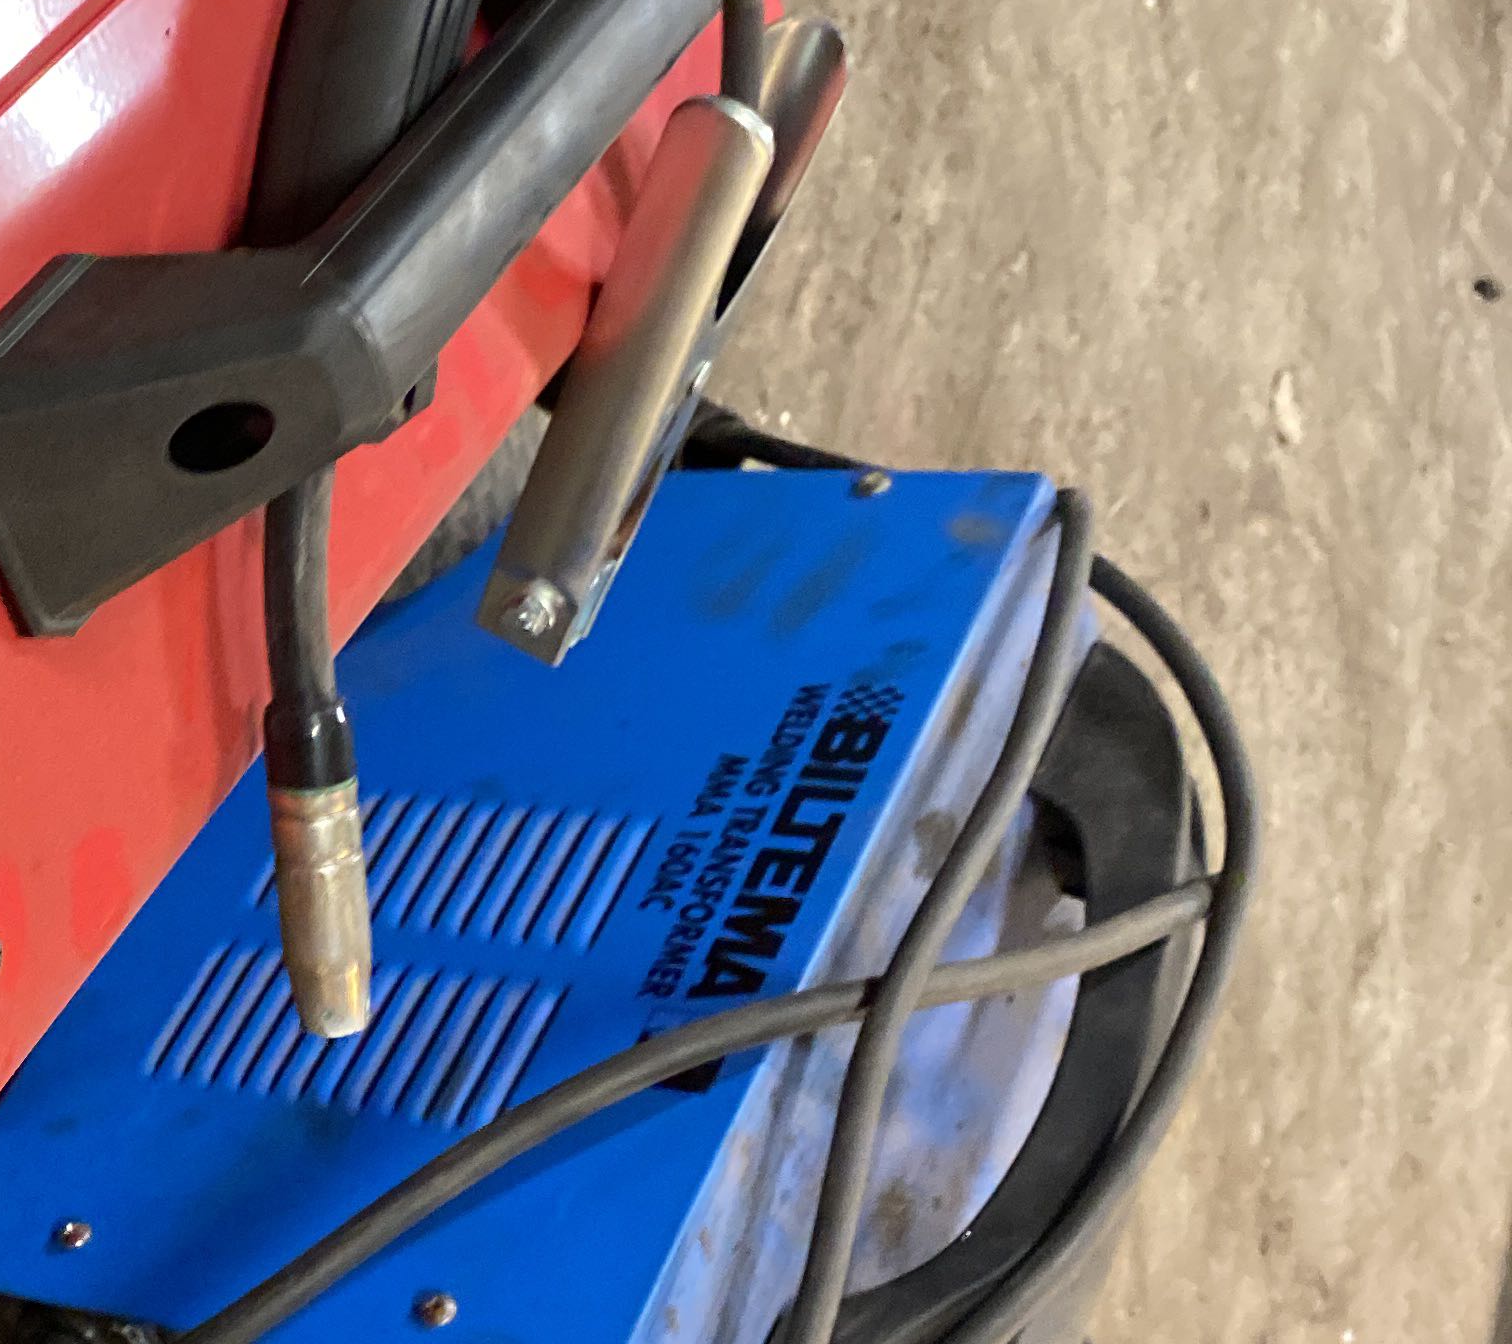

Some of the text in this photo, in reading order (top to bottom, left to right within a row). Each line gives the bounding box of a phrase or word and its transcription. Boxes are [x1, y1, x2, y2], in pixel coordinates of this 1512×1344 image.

[635, 683, 831, 999] WELDING TRANSFORMER
[637, 753, 749, 913] MMA 160AC
[686, 714, 892, 998] BILTEMA
